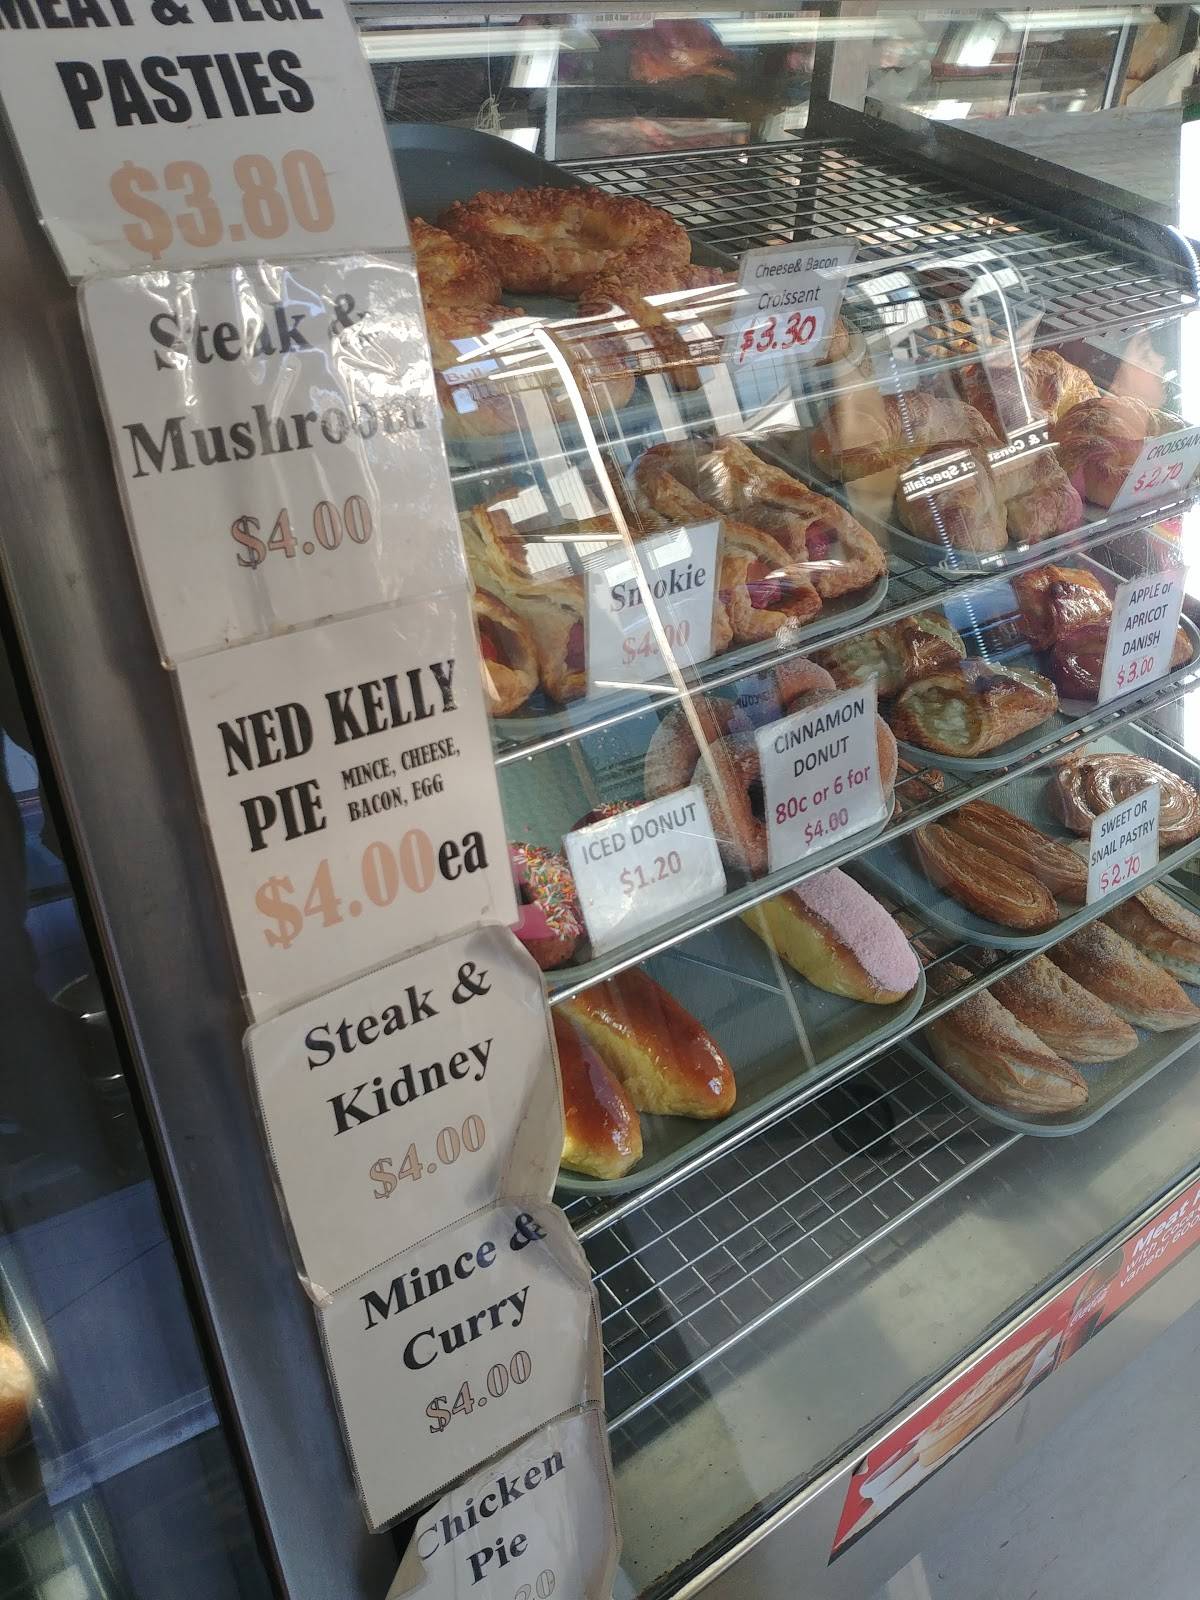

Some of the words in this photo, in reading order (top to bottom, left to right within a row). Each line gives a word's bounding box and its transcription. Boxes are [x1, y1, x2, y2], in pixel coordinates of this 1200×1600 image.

[56, 49, 315, 130] PASTIES
[109, 149, 336, 261] $3.80
[805, 255, 839, 272] Bacon
[757, 285, 822, 311] Croissant
[738, 311, 817, 364] $3.30
[1146, 433, 1200, 461] CROISSAN
[231, 494, 374, 570] $4.00
[1124, 604, 1168, 633] APRICOT
[1128, 582, 1160, 607] APPLE
[1121, 630, 1160, 657] DANISH
[217, 702, 314, 777] NED
[324, 658, 459, 745] KELLY
[773, 698, 865, 754] CINNAMON
[340, 757, 397, 790] MINCE,
[400, 736, 461, 771] CHEESE,
[793, 736, 850, 778] DONUT
[239, 778, 328, 853] PIE
[347, 787, 409, 822] BACON,
[412, 773, 444, 801] EGG
[775, 797, 808, 825] 80c
[812, 786, 829, 806] or
[833, 776, 844, 795] 6
[847, 766, 871, 788] for
[1100, 807, 1132, 838] SWEET
[1133, 800, 1148, 818] OR
[581, 832, 626, 865] ICED
[630, 802, 697, 845] DONUT
[1091, 840, 1117, 867] SNAIL
[1119, 817, 1155, 849] PASTRY
[619, 850, 682, 897] $1.20
[304, 984, 440, 1071] Steak
[452, 961, 492, 1004] &
[326, 1037, 494, 1137] Kidney
[369, 1114, 486, 1200] $4.00
[1131, 1199, 1189, 1258] Meat
[359, 1240, 497, 1331] Mince
[509, 1212, 548, 1251] &
[403, 1285, 530, 1371] Curry
[425, 1350, 532, 1434] $4.00
[416, 1451, 566, 1561] Chicken
[466, 1533, 528, 1586] Pie
